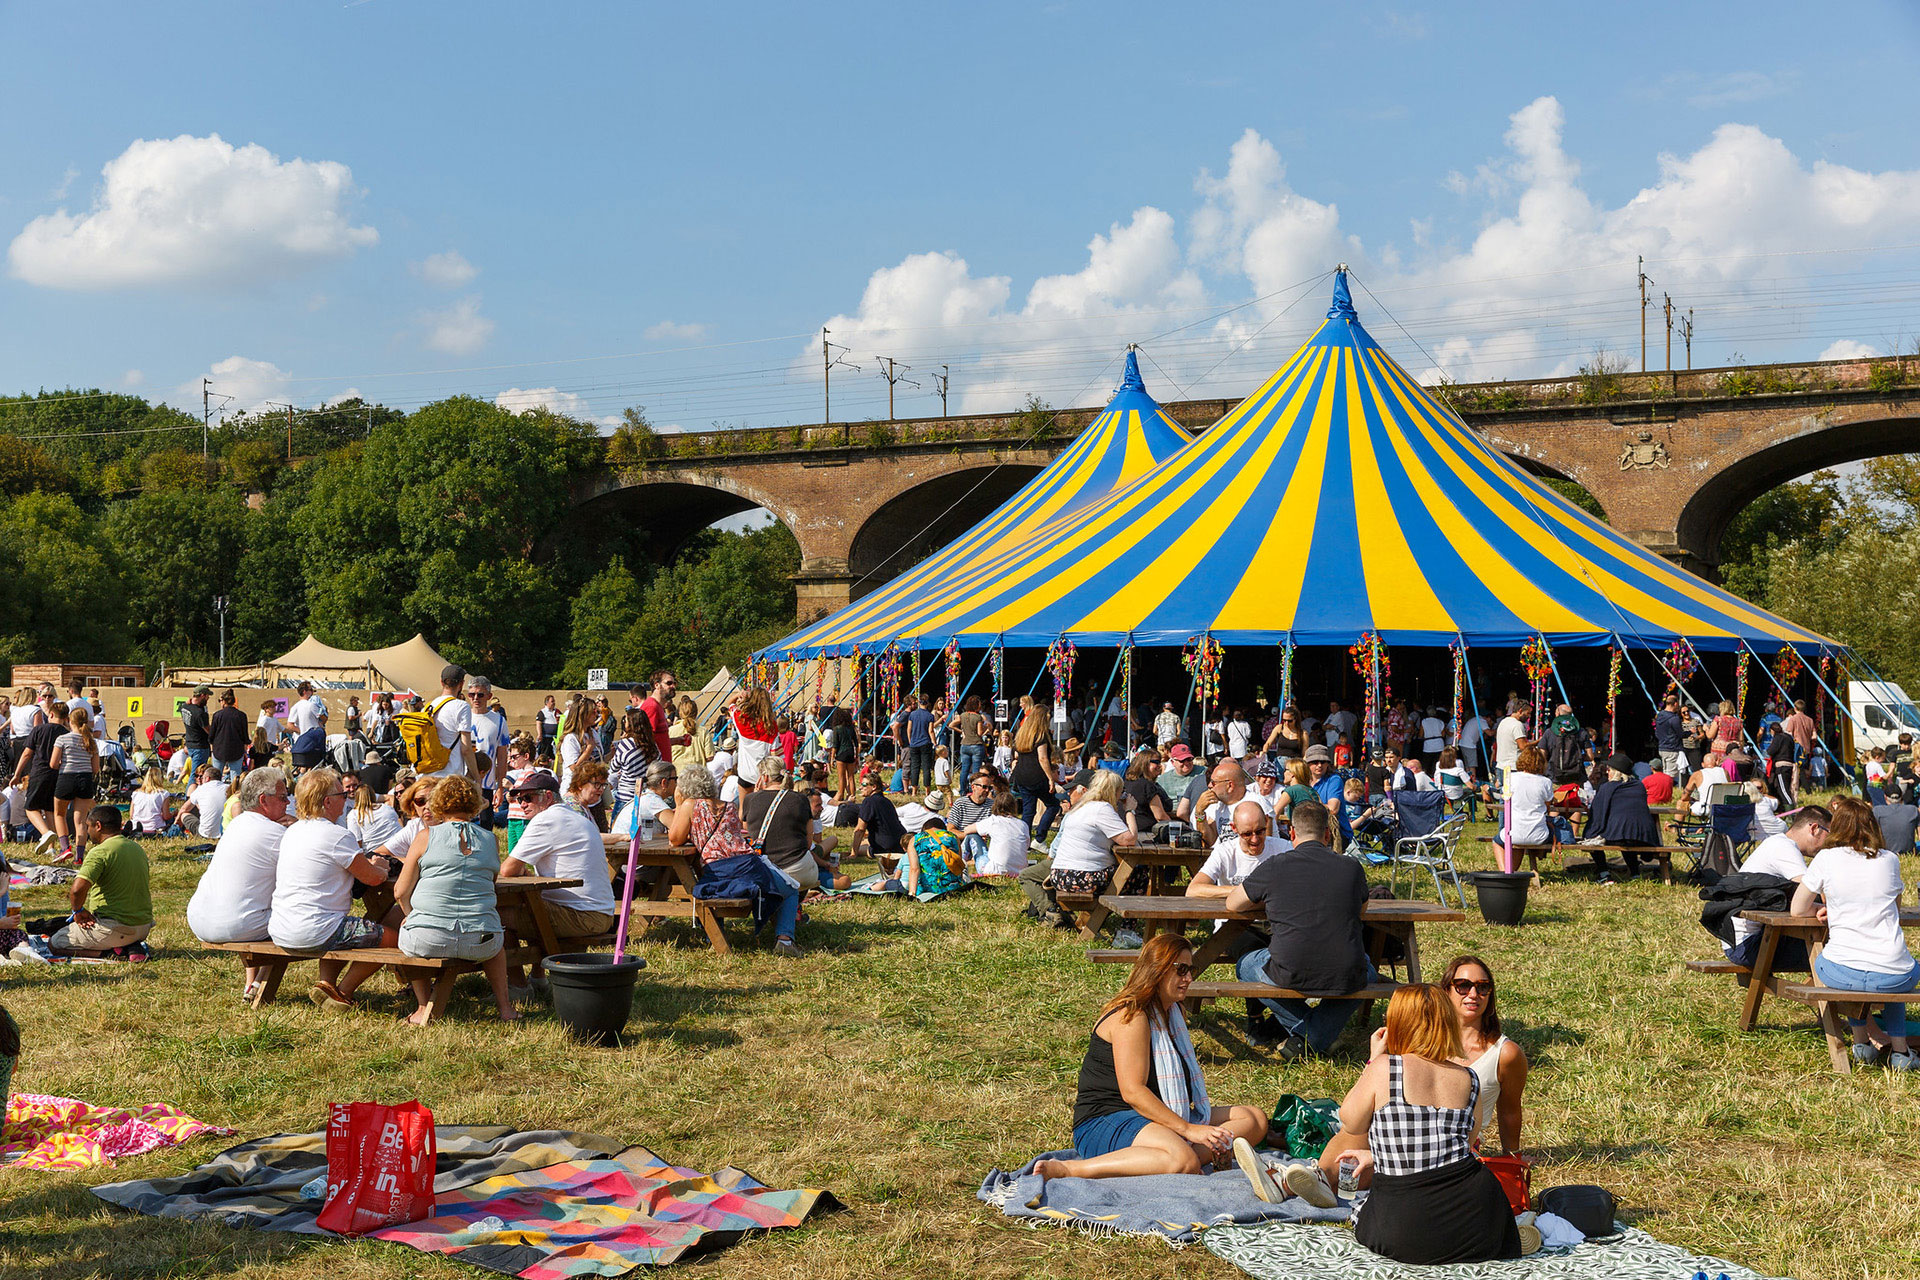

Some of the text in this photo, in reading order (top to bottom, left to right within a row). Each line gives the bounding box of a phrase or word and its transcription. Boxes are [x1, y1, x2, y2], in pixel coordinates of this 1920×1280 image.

[591, 670, 604, 681] BAR
[379, 1122, 403, 1149] Be
[354, 1135, 367, 1189] lululemon
